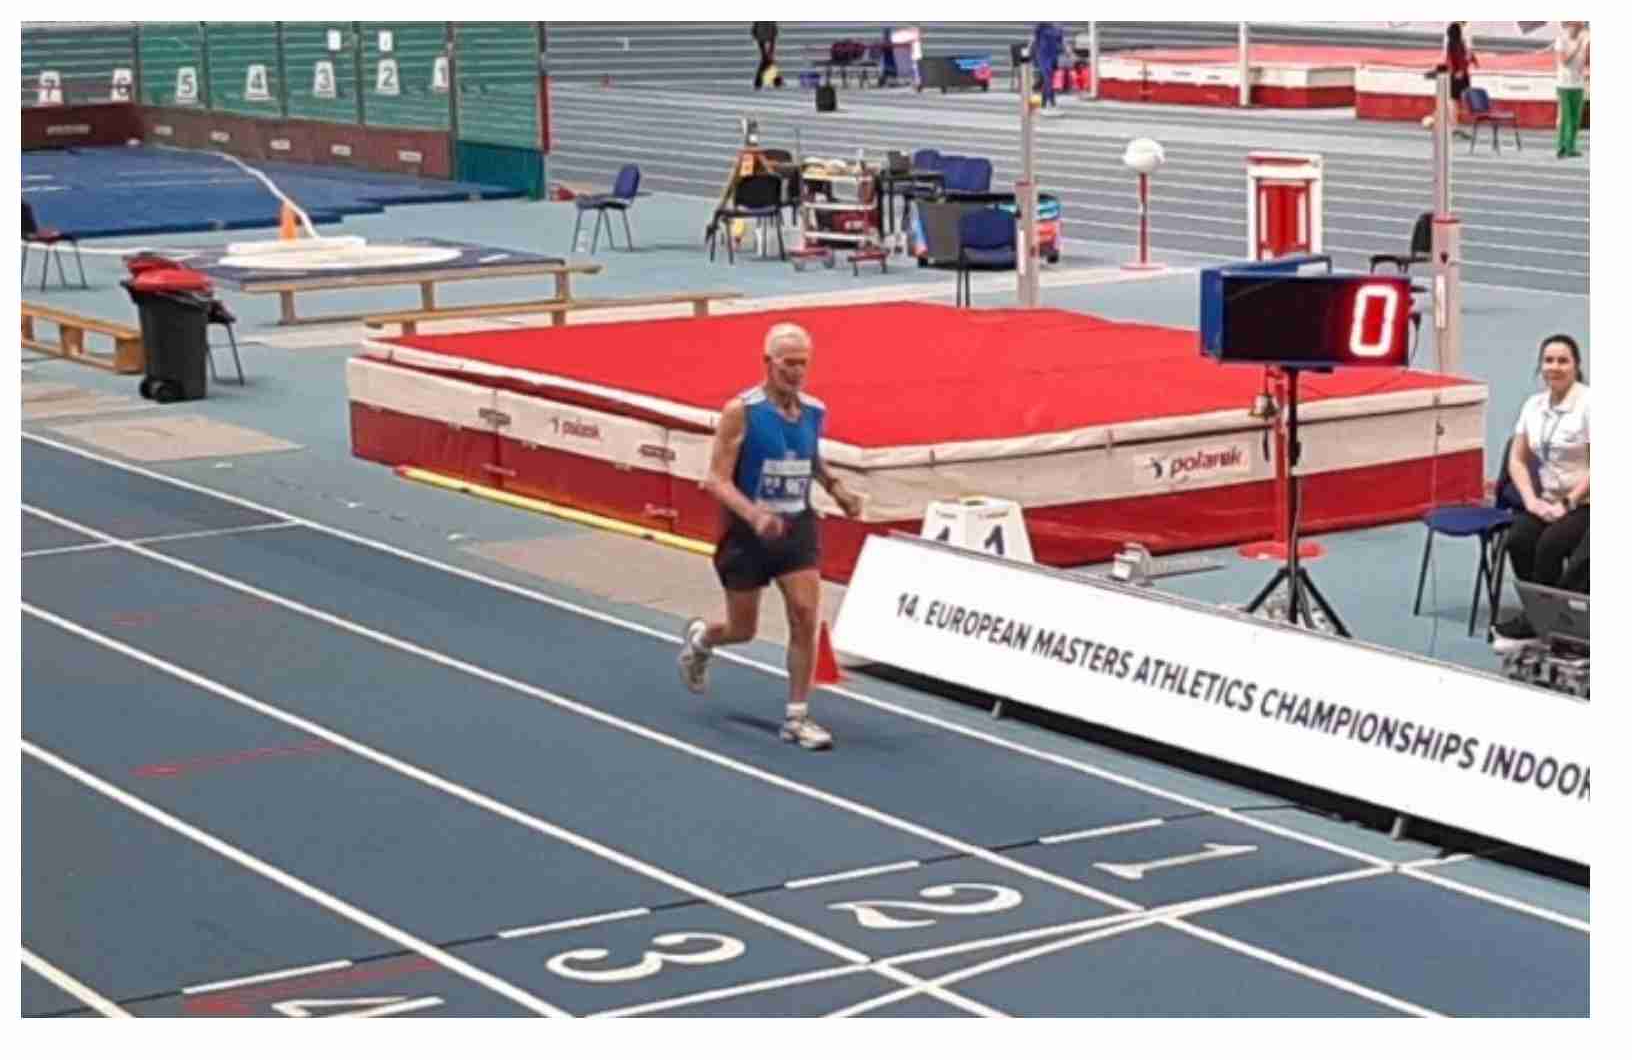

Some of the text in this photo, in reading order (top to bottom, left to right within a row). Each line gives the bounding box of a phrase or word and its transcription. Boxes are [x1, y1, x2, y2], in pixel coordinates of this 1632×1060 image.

[1348, 284, 1399, 356] 0
[896, 592, 921, 621] 14.
[923, 600, 1033, 653] EUROPEAN
[1031, 627, 1136, 681] MASTERS
[1131, 654, 1257, 713] ATHLETICS
[1259, 688, 1480, 771] CHAMPIONSHIPS
[1093, 844, 1258, 880] 1
[829, 882, 1023, 929] 2
[546, 931, 746, 982] 3
